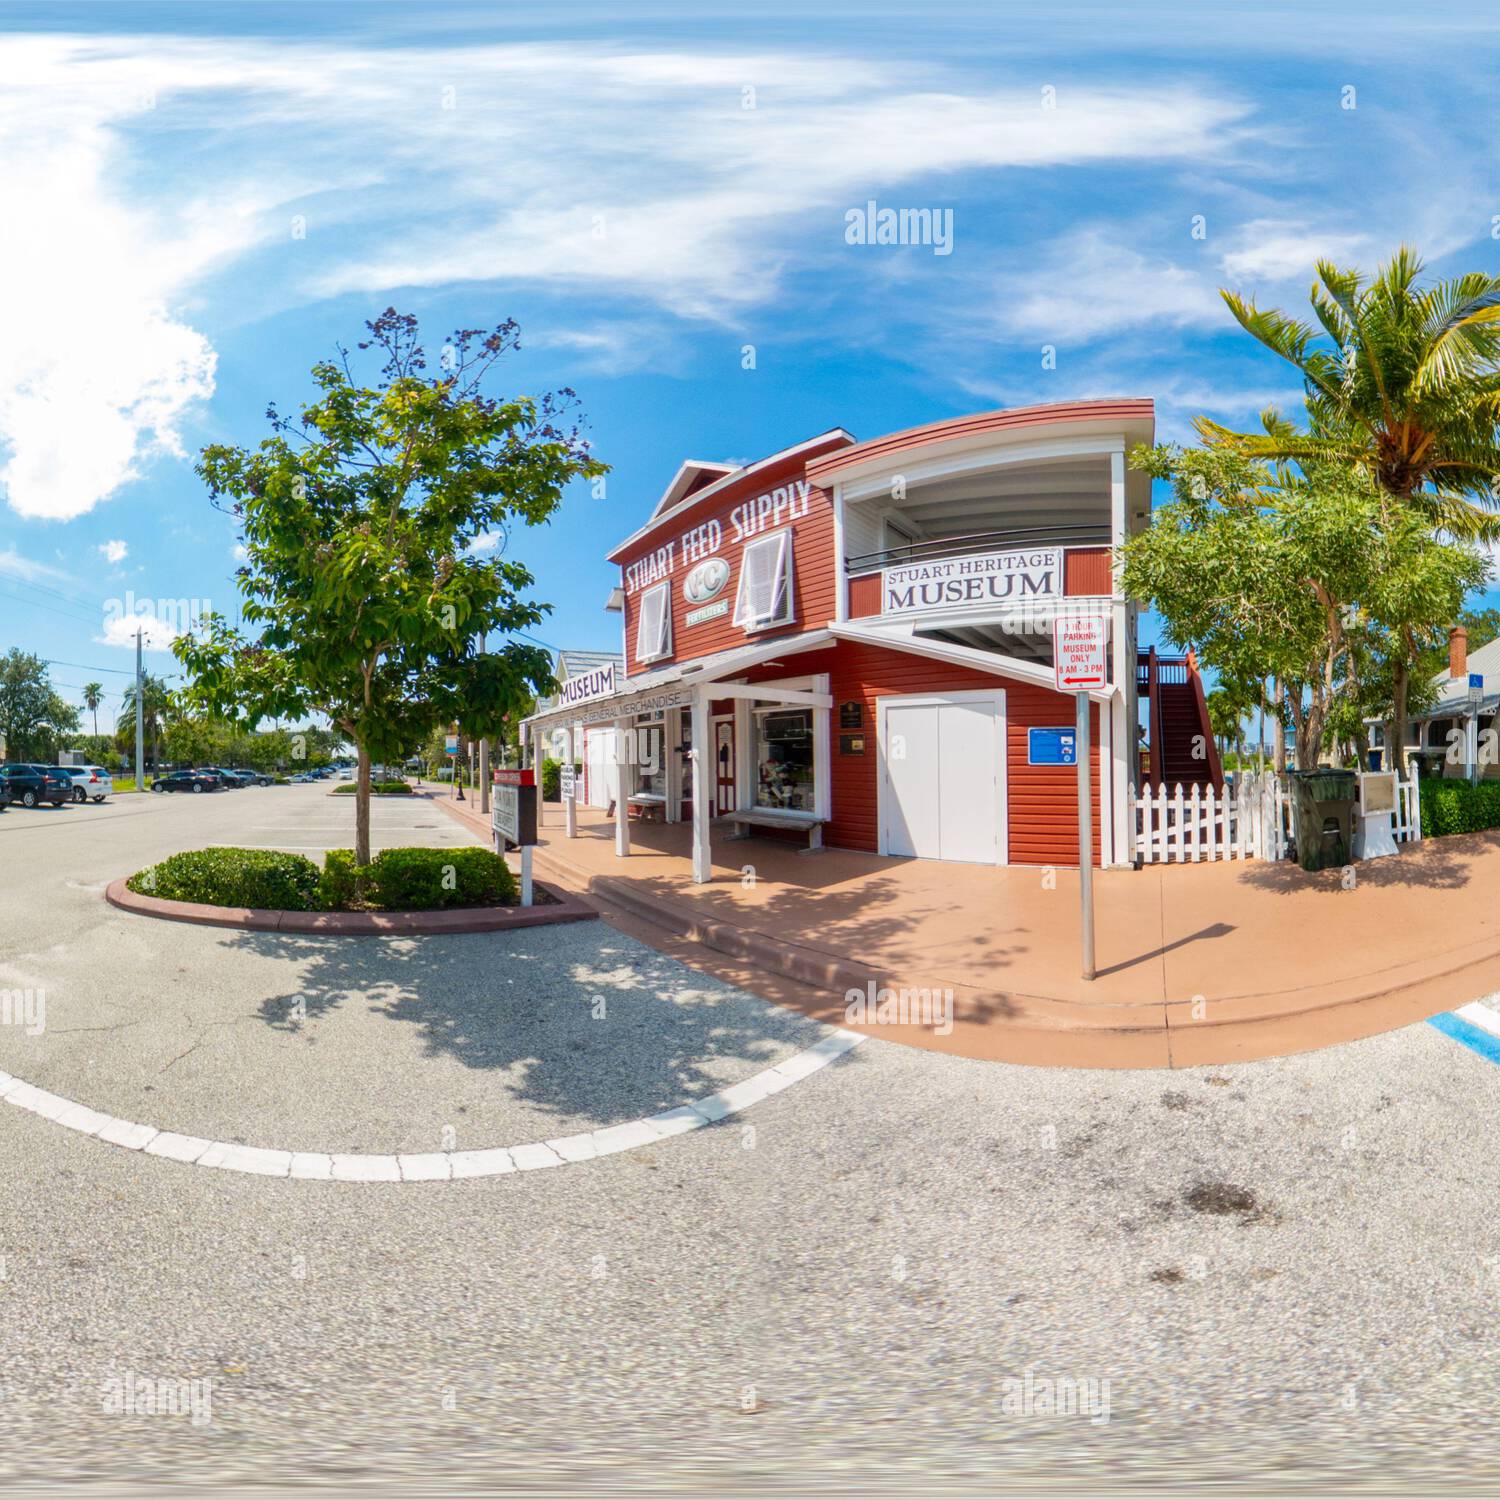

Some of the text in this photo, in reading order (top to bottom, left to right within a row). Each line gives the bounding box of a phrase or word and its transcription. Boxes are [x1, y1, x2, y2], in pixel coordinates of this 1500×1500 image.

[626, 480, 813, 596] STUART FEED SUPPLY
[888, 553, 1055, 585] STUART HERITAGE
[888, 571, 1054, 610] MUSEUM
[1063, 632, 1097, 641] PARKING
[1063, 644, 1097, 653] MUSEUM
[1065, 665, 1077, 674] AM
[1091, 664, 1103, 673] PM
[1070, 655, 1090, 663] ONLY
[560, 667, 613, 705] MUSEUM
[619, 691, 681, 716] MERCHANDISE
